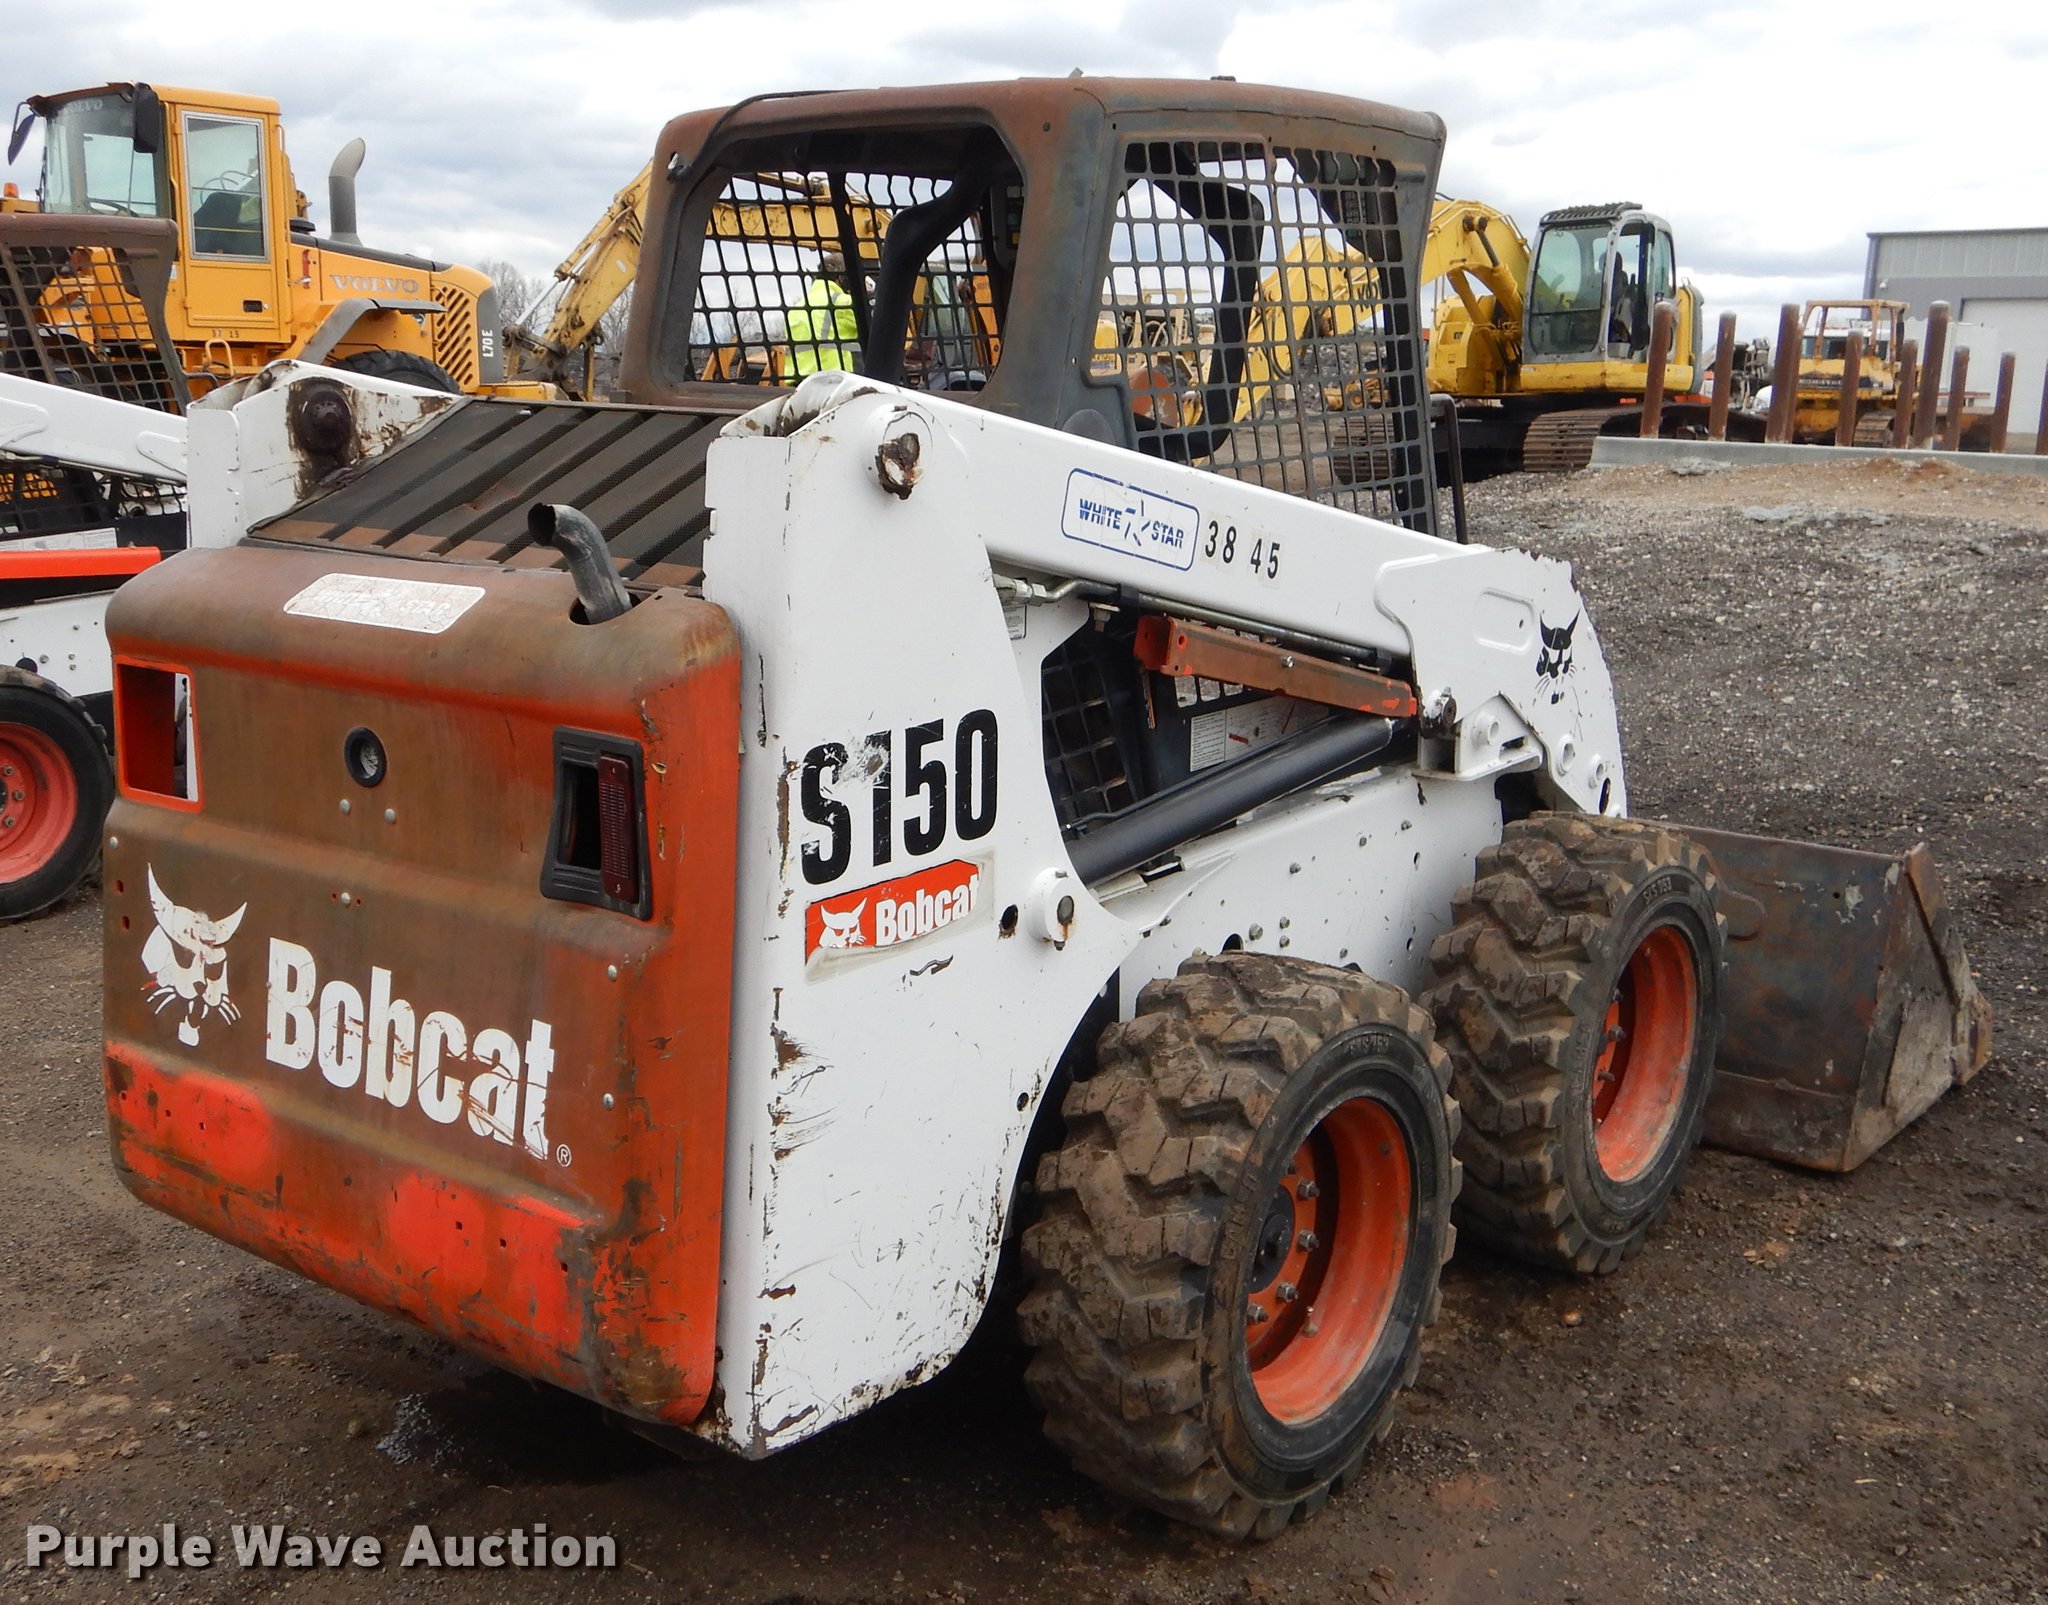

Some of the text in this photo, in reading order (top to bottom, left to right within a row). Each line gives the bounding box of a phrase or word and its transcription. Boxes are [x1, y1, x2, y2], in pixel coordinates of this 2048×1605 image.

[329, 274, 419, 293] VOLVO
[481, 329, 494, 358] L70E
[1079, 498, 1185, 549] WHITE STAR
[1205, 520, 1281, 579] 38 45
[801, 708, 998, 885] S150
[875, 873, 980, 947] Bobcat
[265, 937, 555, 1161] Bobcat
